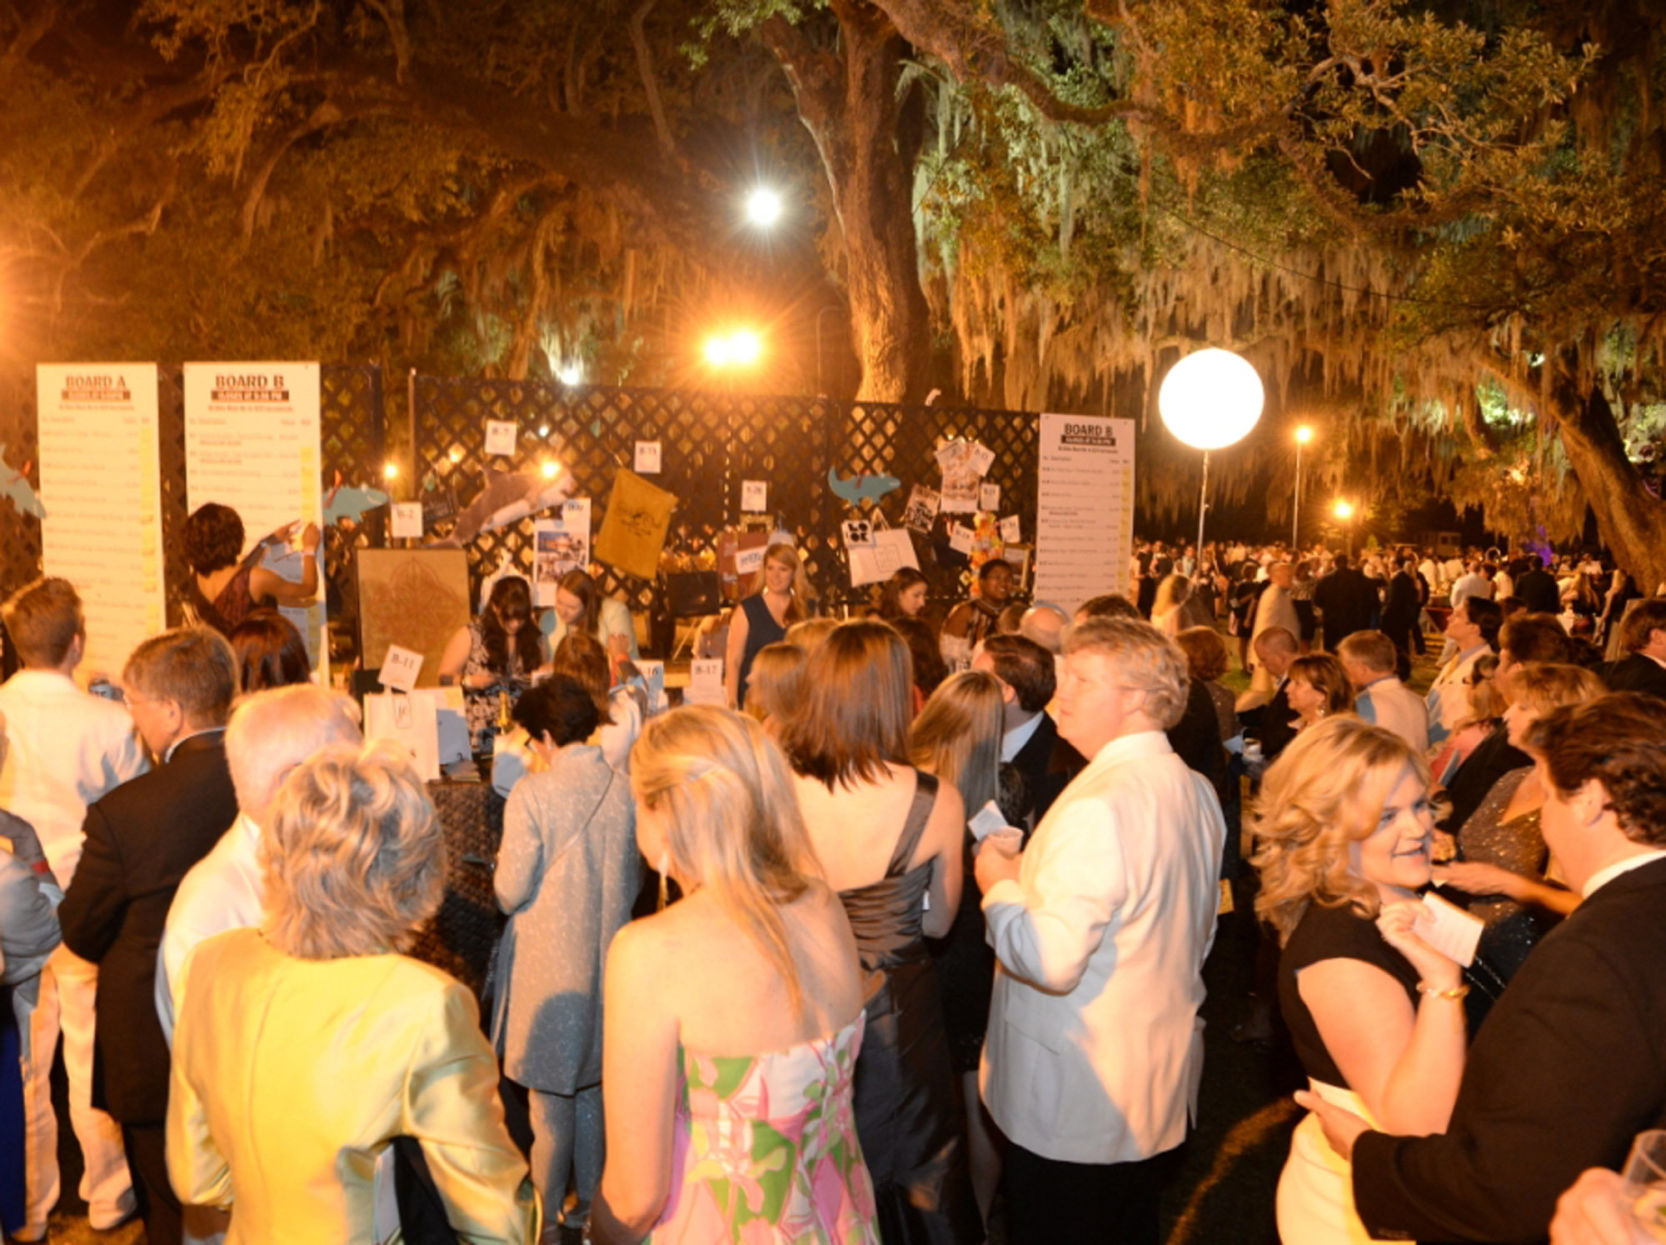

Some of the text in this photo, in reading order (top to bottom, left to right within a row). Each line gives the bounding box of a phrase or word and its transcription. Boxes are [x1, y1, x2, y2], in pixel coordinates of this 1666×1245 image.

[66, 375, 126, 390] BOARD A
[215, 374, 284, 388] BOARD B
[1064, 423, 1113, 437] BOARD B
[695, 665, 718, 676] B-17
